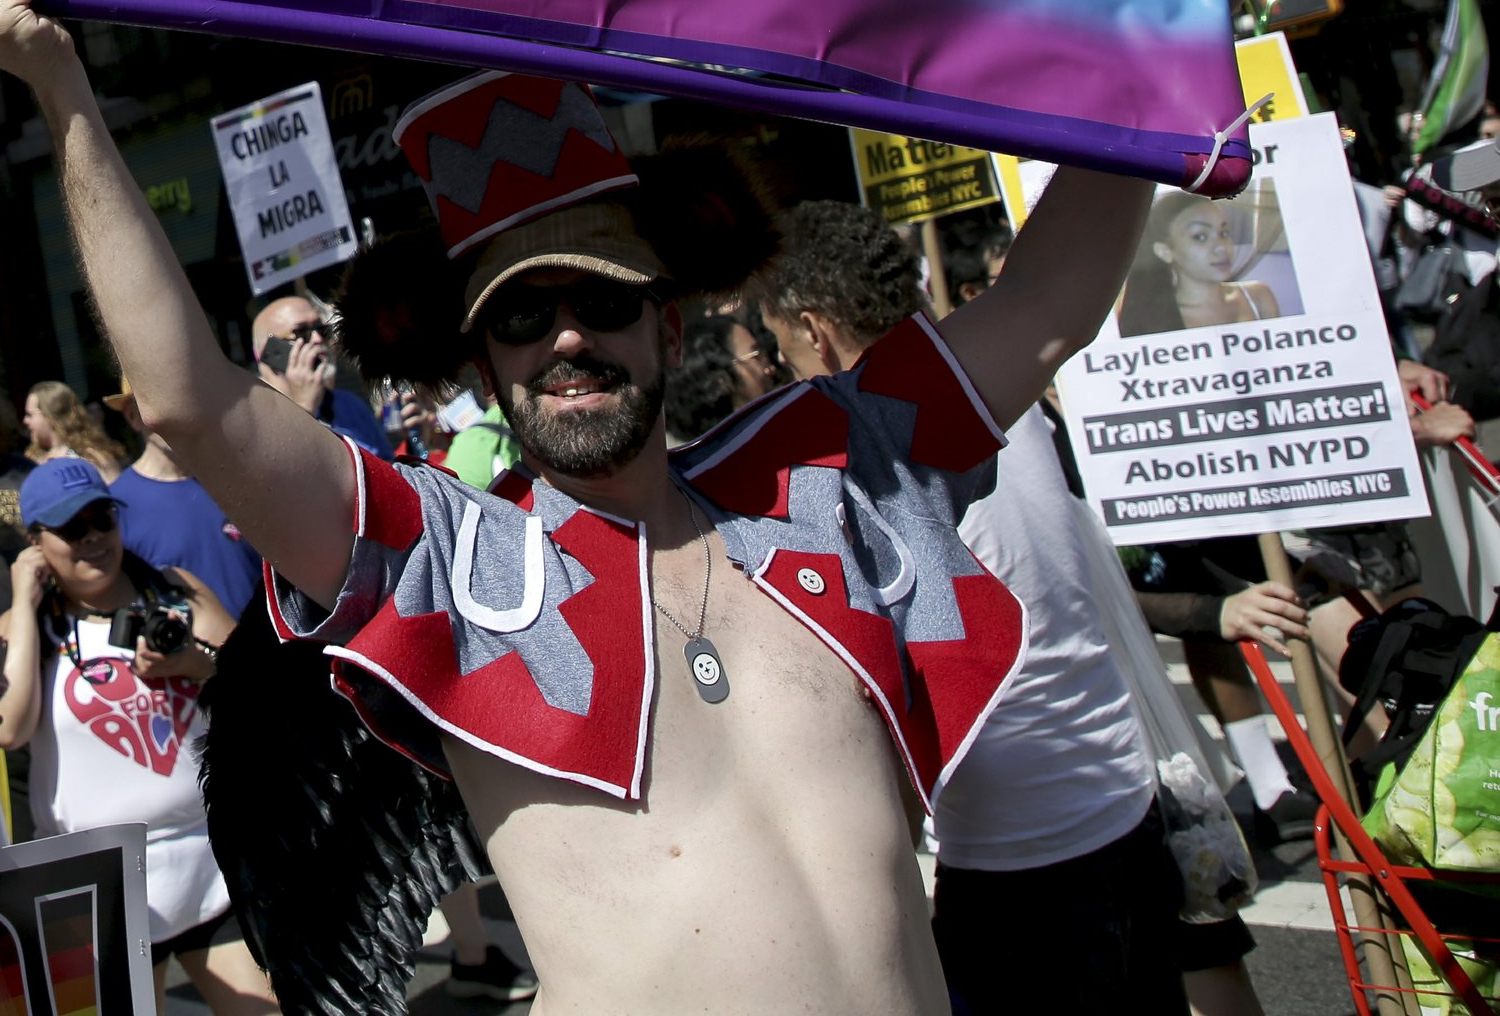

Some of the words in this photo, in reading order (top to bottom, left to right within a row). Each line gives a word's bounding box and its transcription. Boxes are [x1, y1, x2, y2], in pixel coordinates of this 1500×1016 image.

[231, 111, 309, 160] CHINGA
[268, 160, 291, 188] LA
[257, 190, 325, 239] MIGRA
[1084, 341, 1212, 375] Layleen
[1221, 323, 1357, 356] Polanco
[1119, 359, 1334, 402] Xtravaganza
[1085, 420, 1173, 449] Trans
[1179, 407, 1258, 438] Lives
[1266, 388, 1387, 426] Matter!
[1124, 449, 1259, 485] Abolish
[1268, 436, 1371, 469] NYPD
[1115, 494, 1190, 521] People's
[1194, 487, 1248, 513] Power
[1249, 478, 1352, 507] Assemblies
[1356, 473, 1392, 496] NYC
[120, 690, 171, 720] FOR
